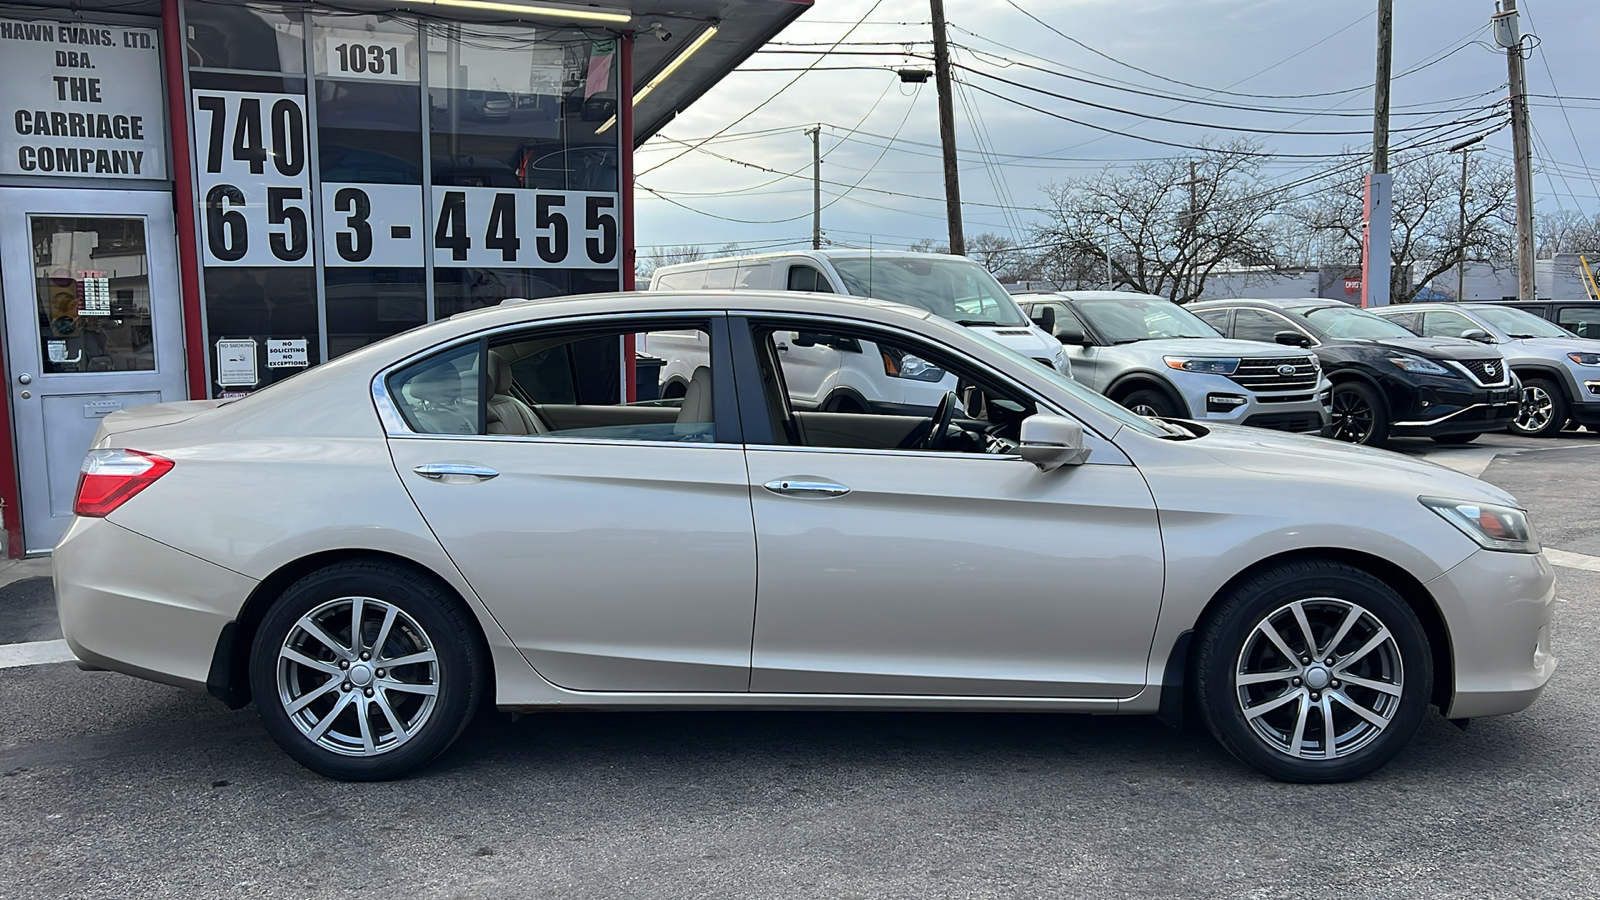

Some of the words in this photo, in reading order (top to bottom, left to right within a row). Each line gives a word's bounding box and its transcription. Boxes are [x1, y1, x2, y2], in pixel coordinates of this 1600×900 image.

[1, 22, 54, 42] HAWN
[58, 26, 116, 46] EVANS.
[123, 31, 156, 49] LTD.
[55, 50, 96, 69] DBA.
[335, 43, 398, 75] 1031
[53, 76, 102, 103] THE
[14, 109, 144, 140] CARRIAGE
[198, 96, 305, 177] 740
[18, 145, 144, 175] COMPANY
